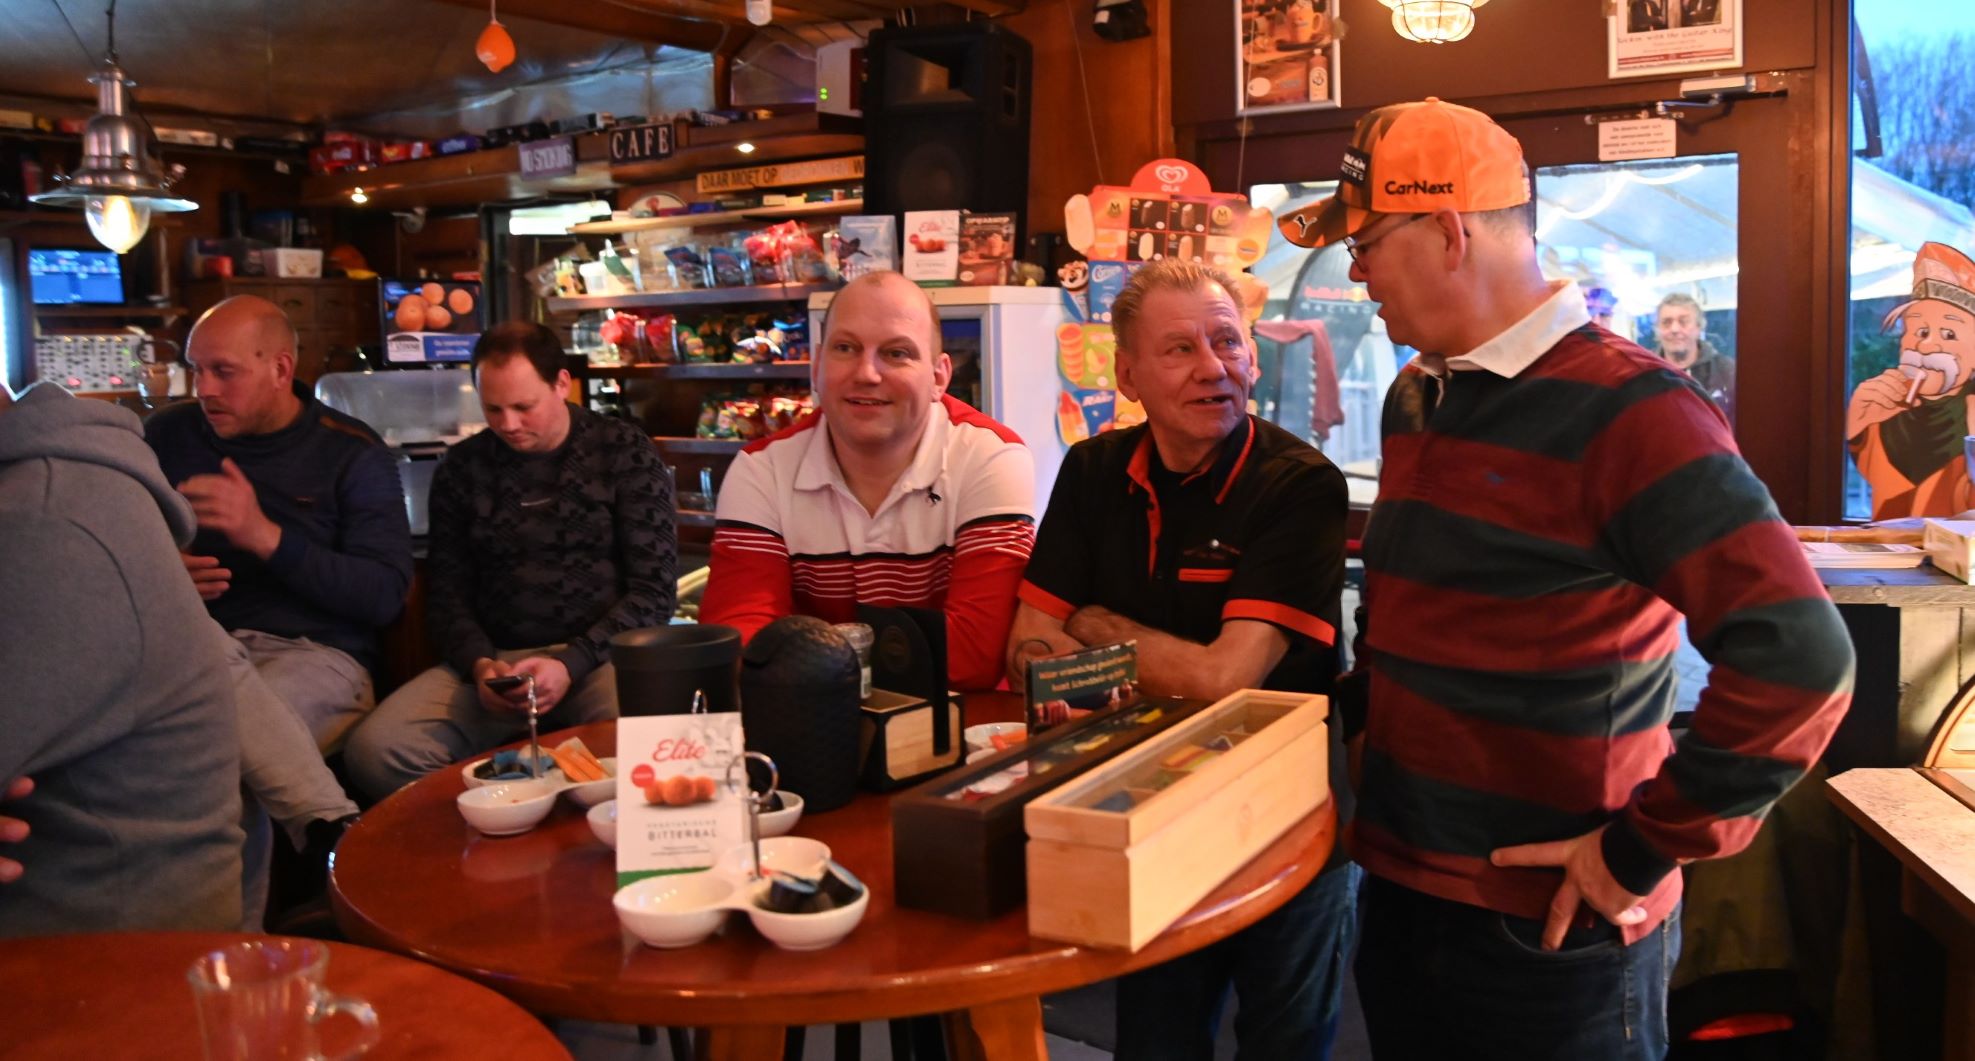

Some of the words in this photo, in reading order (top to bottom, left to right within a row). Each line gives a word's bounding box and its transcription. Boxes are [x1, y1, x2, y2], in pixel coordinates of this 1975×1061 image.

[612, 126, 670, 159] CAFE
[701, 172, 729, 189] DAAR
[731, 169, 760, 187] MOET
[763, 167, 778, 184] OP
[1384, 180, 1454, 196] CarNext
[653, 738, 705, 762] Elite
[648, 828, 717, 841] BITTERBAL
